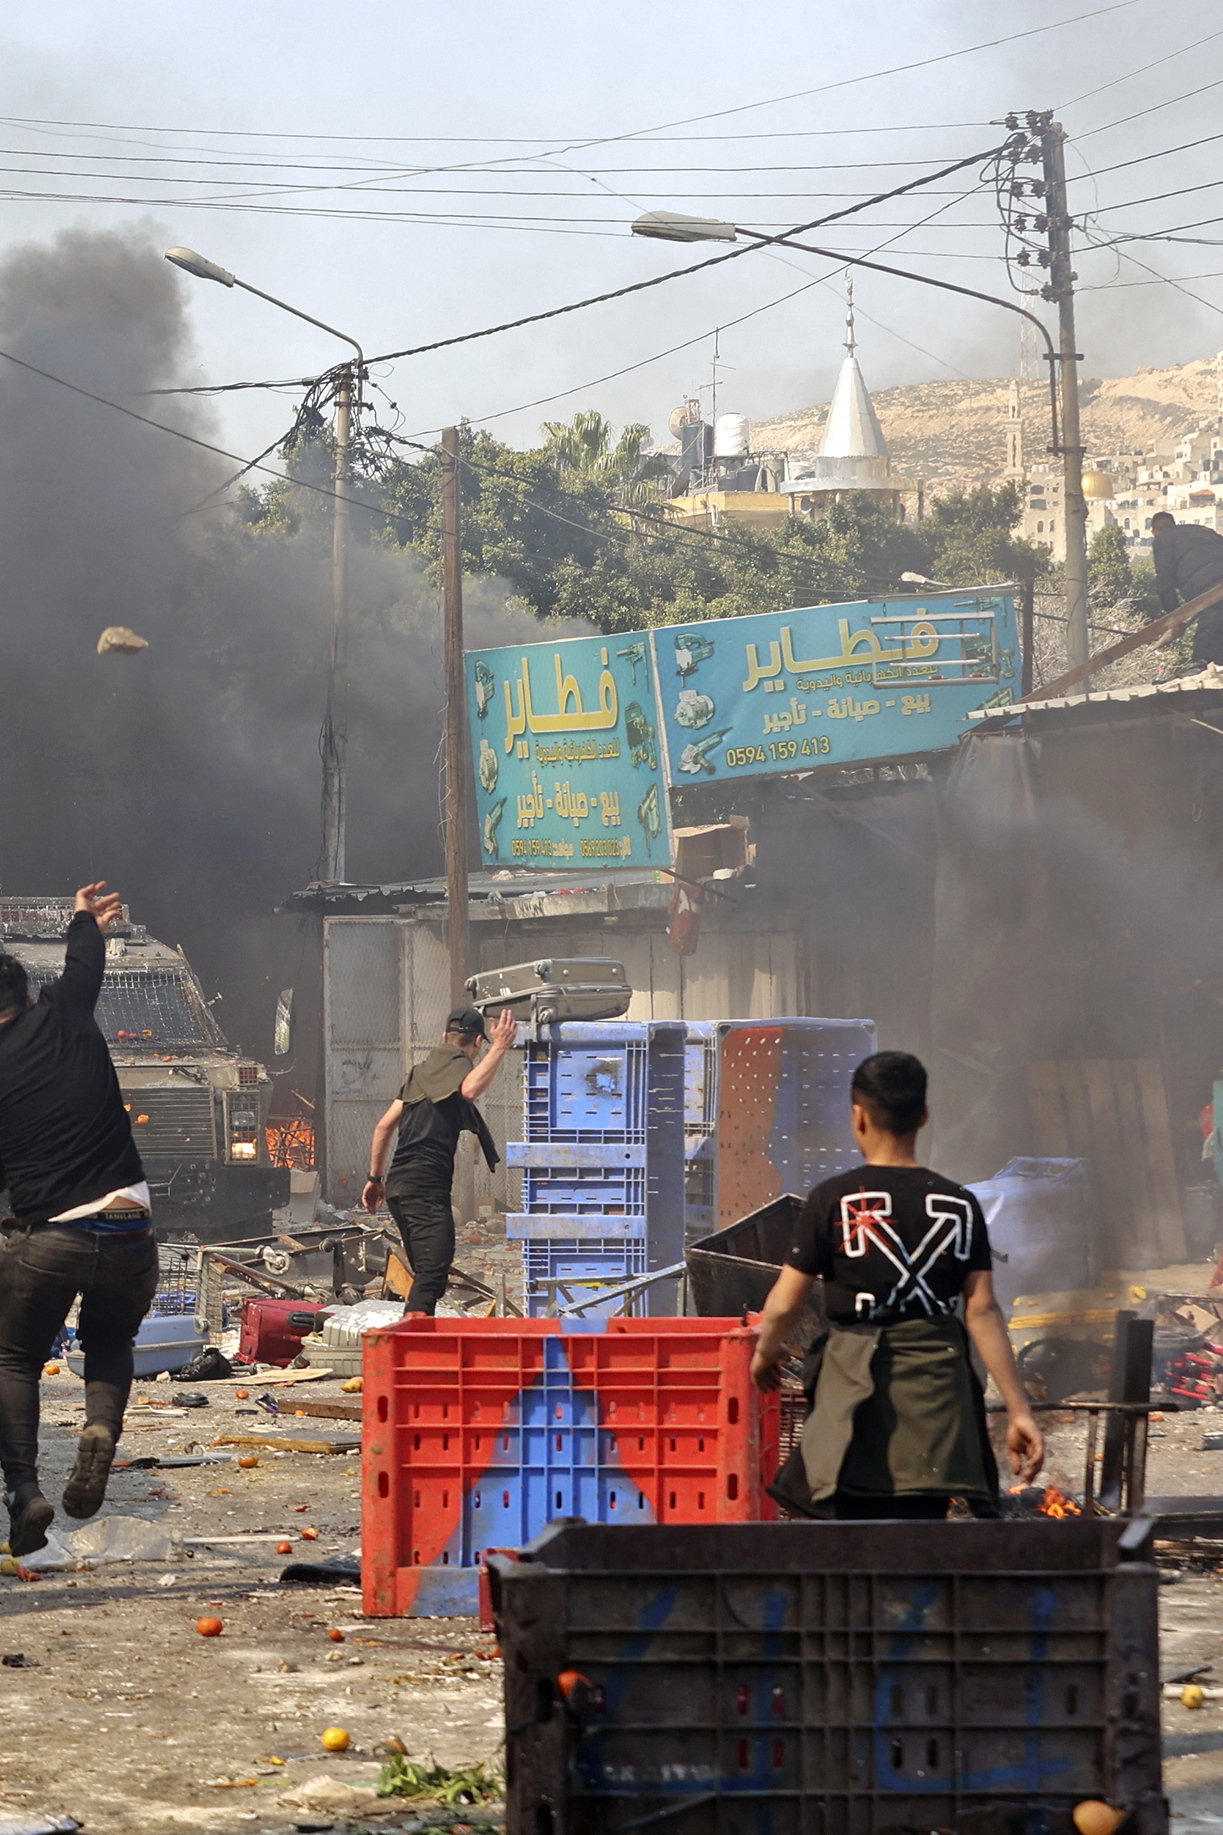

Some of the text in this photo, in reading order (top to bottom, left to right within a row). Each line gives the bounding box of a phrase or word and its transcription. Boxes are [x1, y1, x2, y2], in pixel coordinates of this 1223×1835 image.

[743, 607, 939, 692] فطاير
[796, 674, 843, 693] واليدوية
[504, 647, 618, 759] فطاير
[762, 697, 807, 734] تأجير
[827, 696, 881, 721] صيانة
[901, 693, 931, 715] بيع
[535, 737, 620, 768] للعدد الكهربائية واليدوية
[727, 736, 831, 768] 0594 159 413
[517, 770, 544, 828] تأجير
[555, 781, 589, 827] صيانة
[600, 791, 621, 826] بيع
[511, 839, 527, 857] 0594
[528, 839, 540, 857] 159
